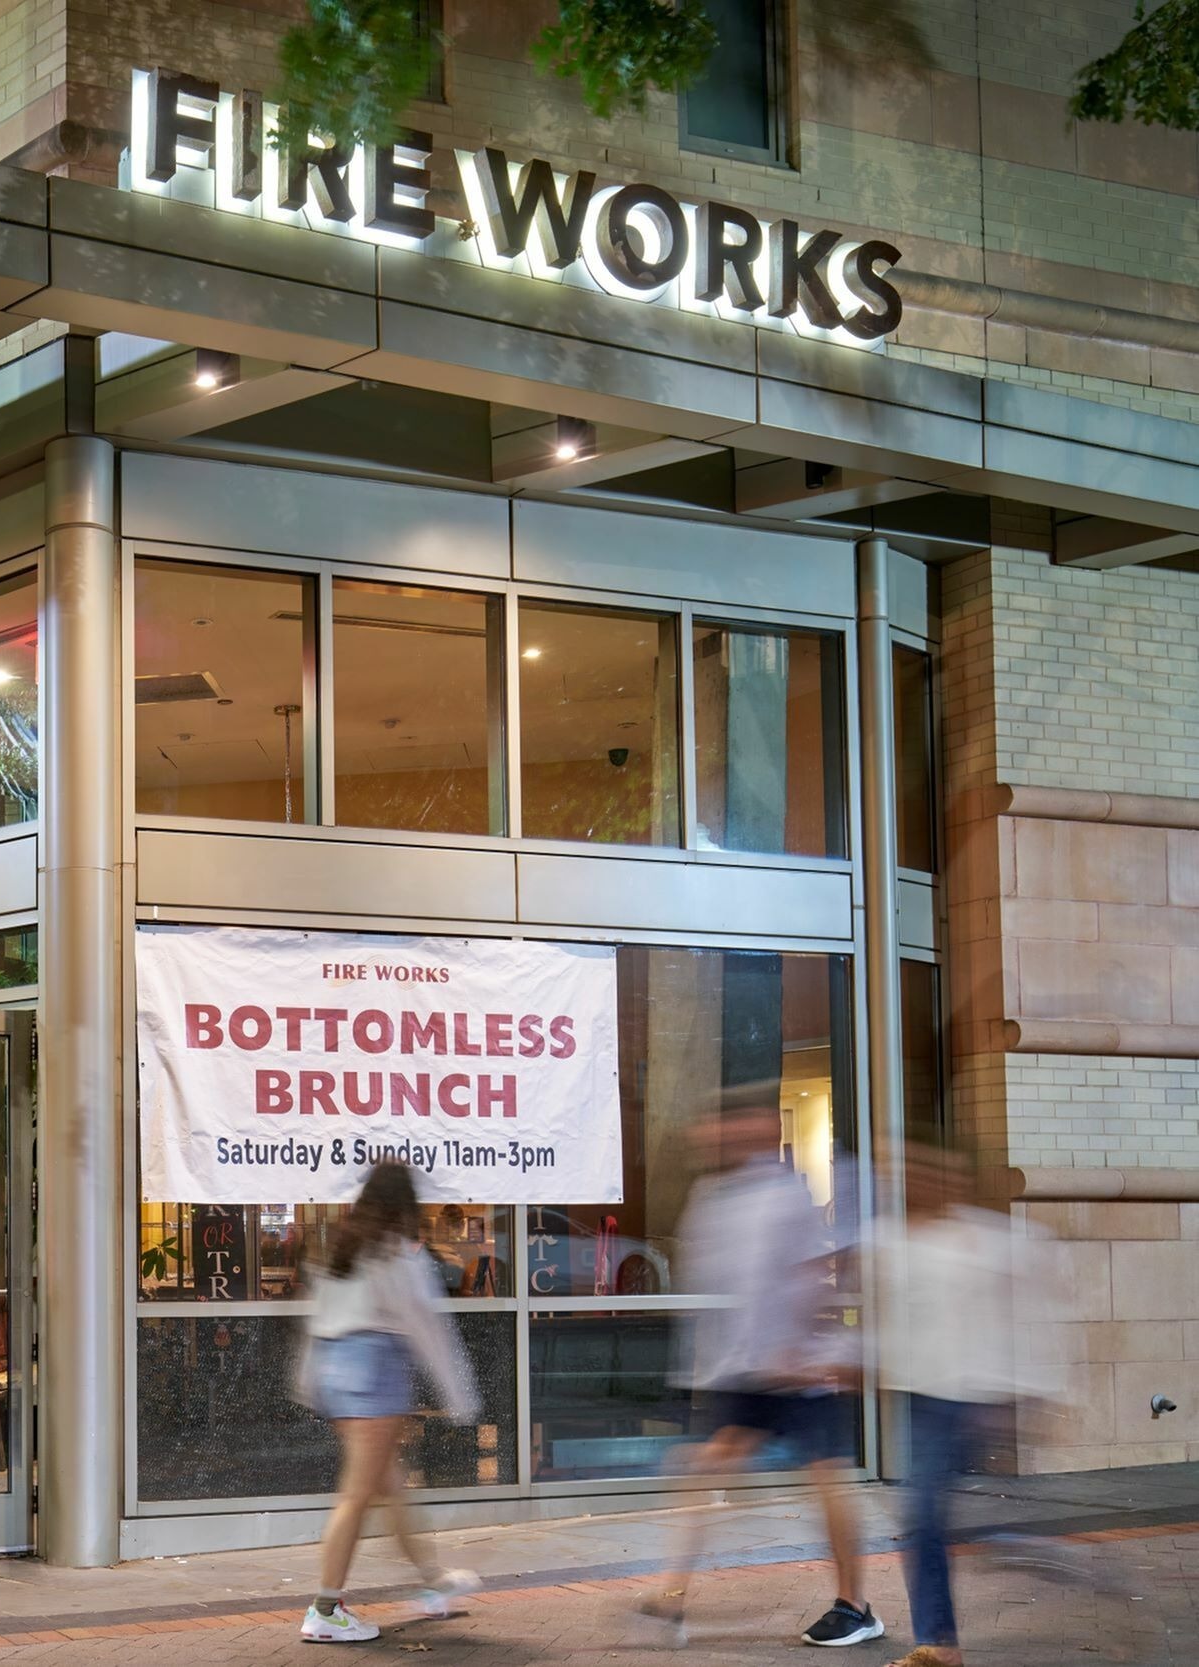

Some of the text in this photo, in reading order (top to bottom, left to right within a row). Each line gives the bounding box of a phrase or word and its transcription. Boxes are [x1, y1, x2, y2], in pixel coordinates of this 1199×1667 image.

[141, 66, 905, 342] FIRE WORKS
[322, 962, 450, 984] FIRE WORKS
[184, 1003, 578, 1060] BOTTOMLESS
[254, 1069, 518, 1118] BRUNCH
[216, 1137, 556, 1173] Saturday & Sunday 11am-3pm
[203, 1222, 234, 1248] OR
